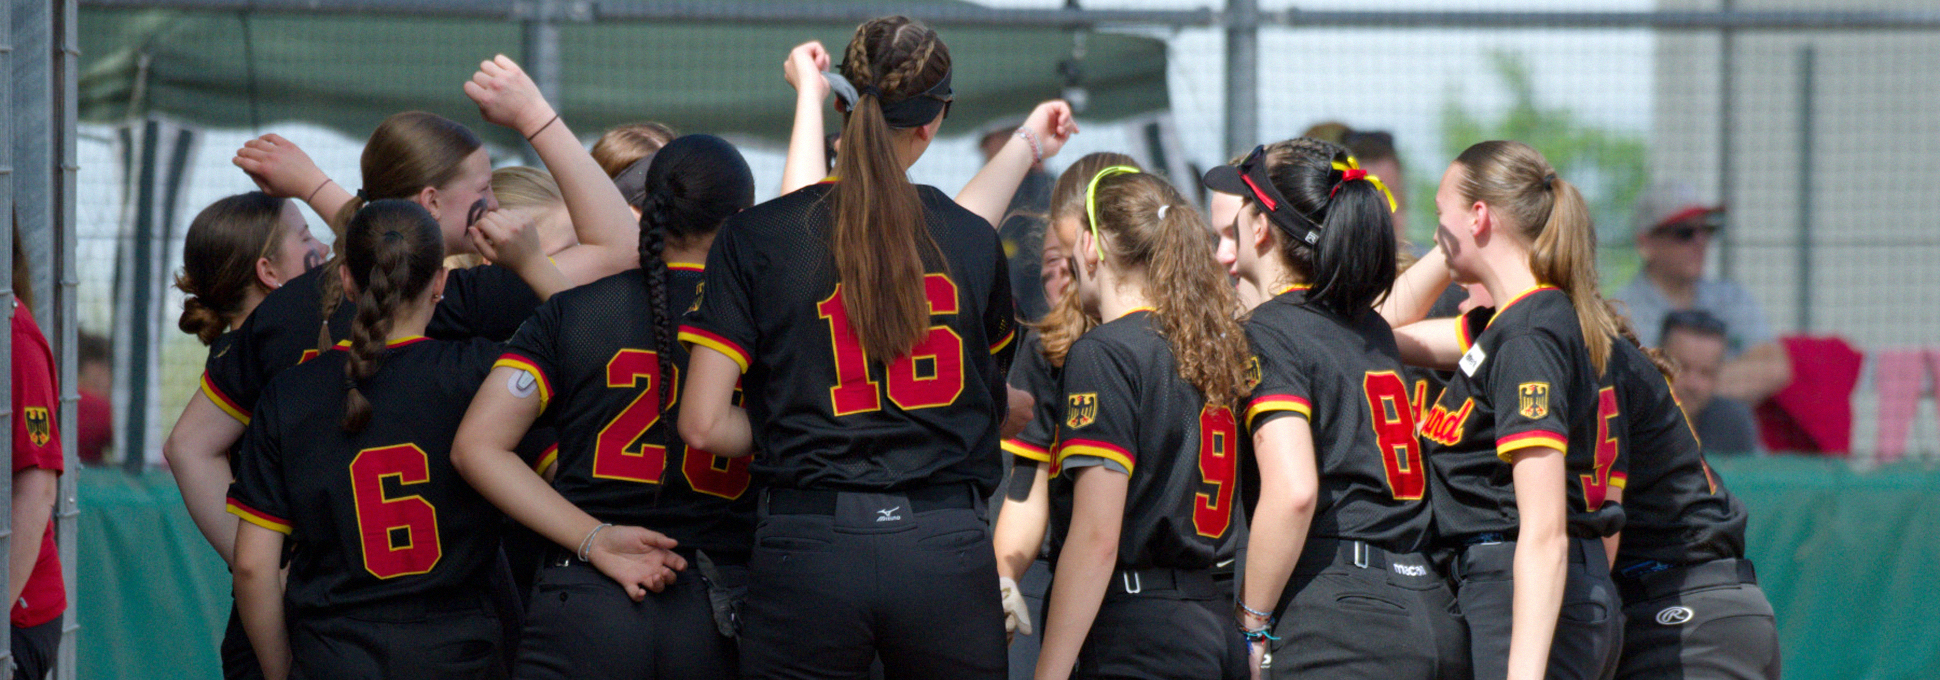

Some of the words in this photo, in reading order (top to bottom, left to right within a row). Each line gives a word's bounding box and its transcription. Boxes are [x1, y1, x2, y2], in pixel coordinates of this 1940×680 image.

[817, 273, 964, 416] 16
[1193, 403, 1237, 539] 9
[1363, 371, 1425, 500] 8
[350, 442, 442, 580] 6
